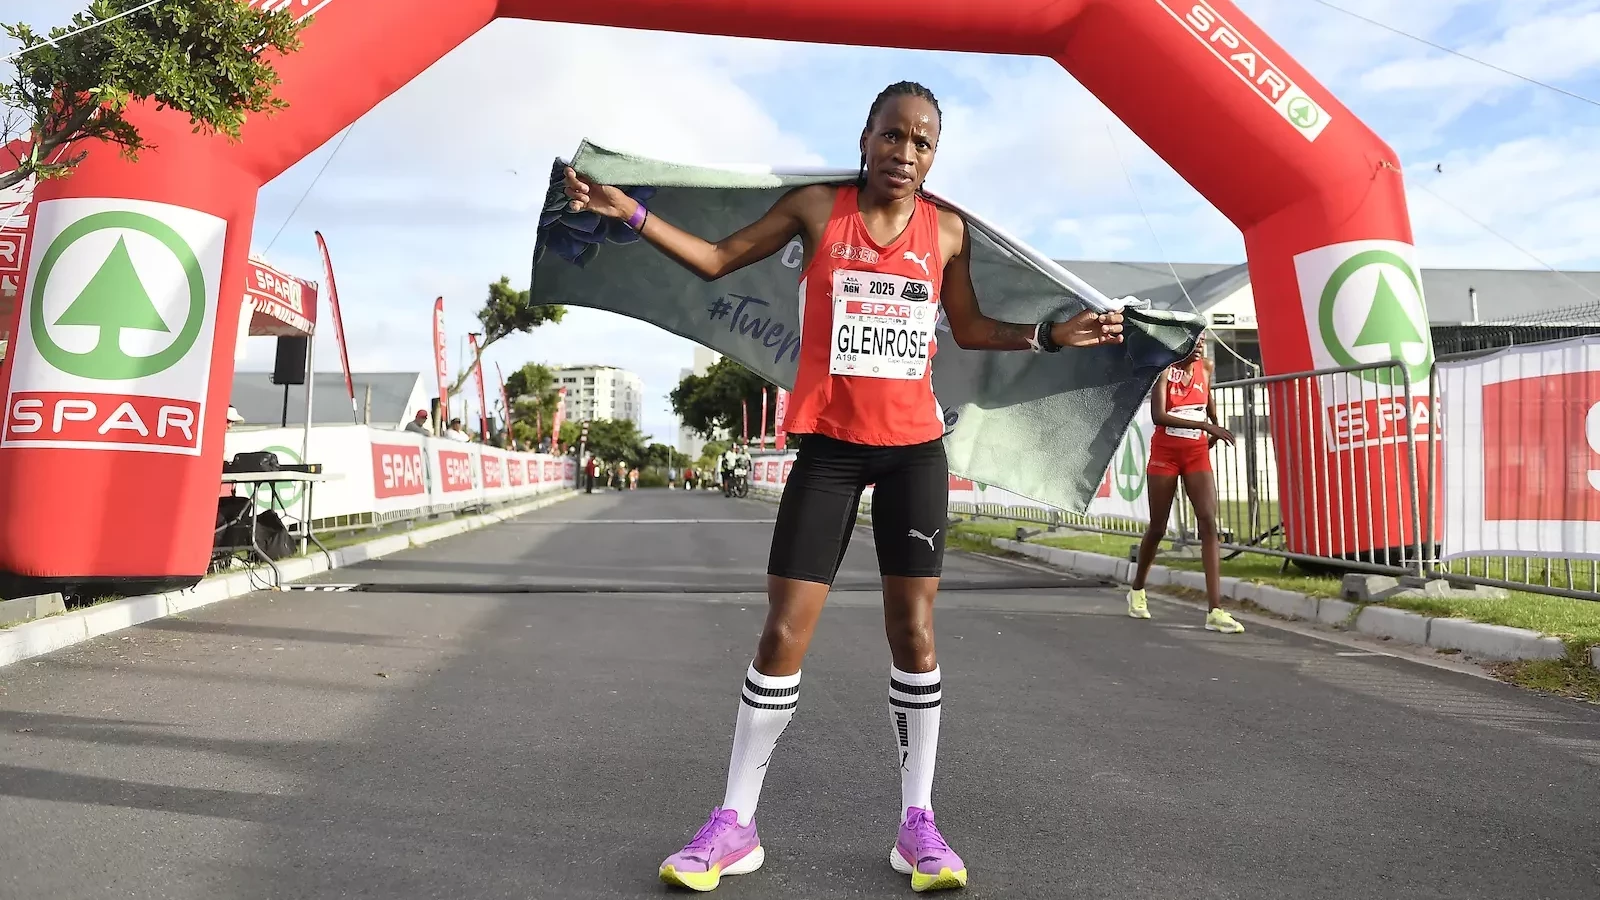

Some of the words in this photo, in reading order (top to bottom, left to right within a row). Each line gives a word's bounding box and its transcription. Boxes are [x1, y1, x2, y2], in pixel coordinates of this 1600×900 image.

[1186, 4, 1286, 99] SPAR
[255, 269, 290, 302] SPAR
[843, 285, 860, 294] AGN
[869, 281, 895, 296] 2025
[905, 282, 928, 295] ASA
[860, 303, 911, 319] SPAR
[837, 324, 928, 359] GLENROSE
[836, 353, 858, 362] A196
[11, 399, 195, 441] SPAR
[381, 453, 424, 489] SPAR
[445, 457, 473, 485] SPAR
